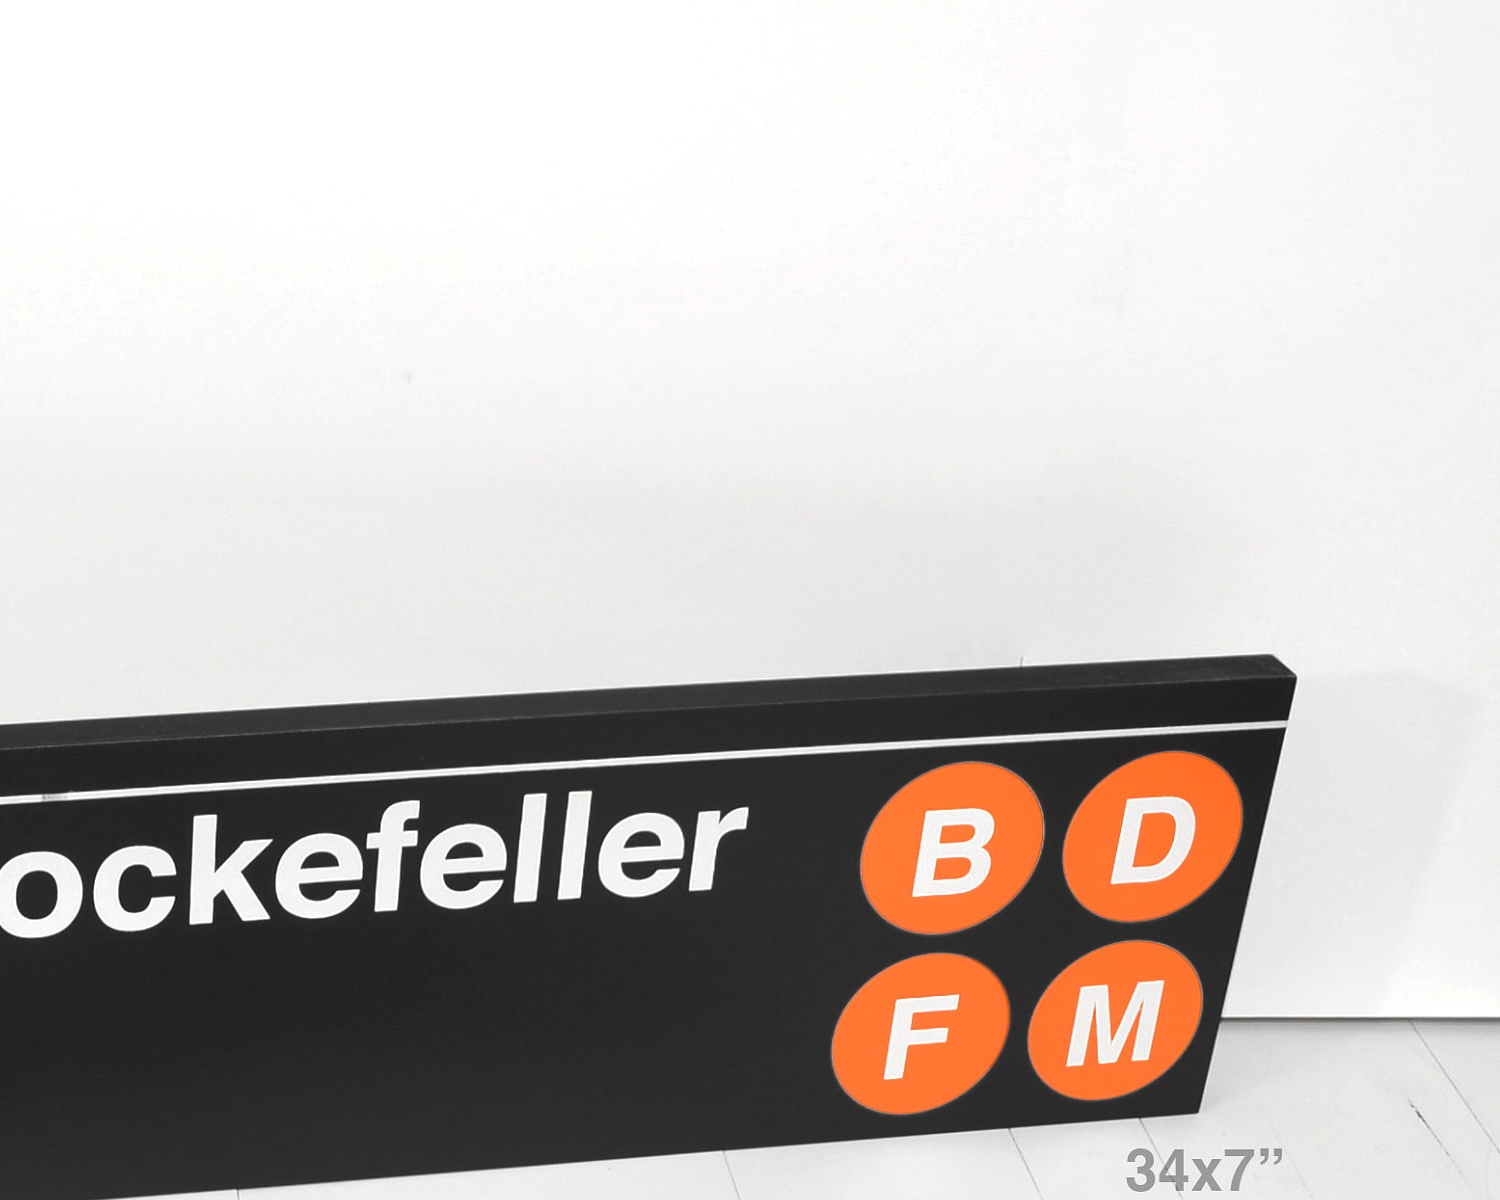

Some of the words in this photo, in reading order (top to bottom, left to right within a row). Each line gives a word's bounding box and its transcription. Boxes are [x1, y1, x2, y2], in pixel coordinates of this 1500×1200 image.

[912, 808, 995, 898] B
[1111, 796, 1197, 885] D
[883, 994, 960, 1081] F
[1065, 979, 1165, 1068] M
